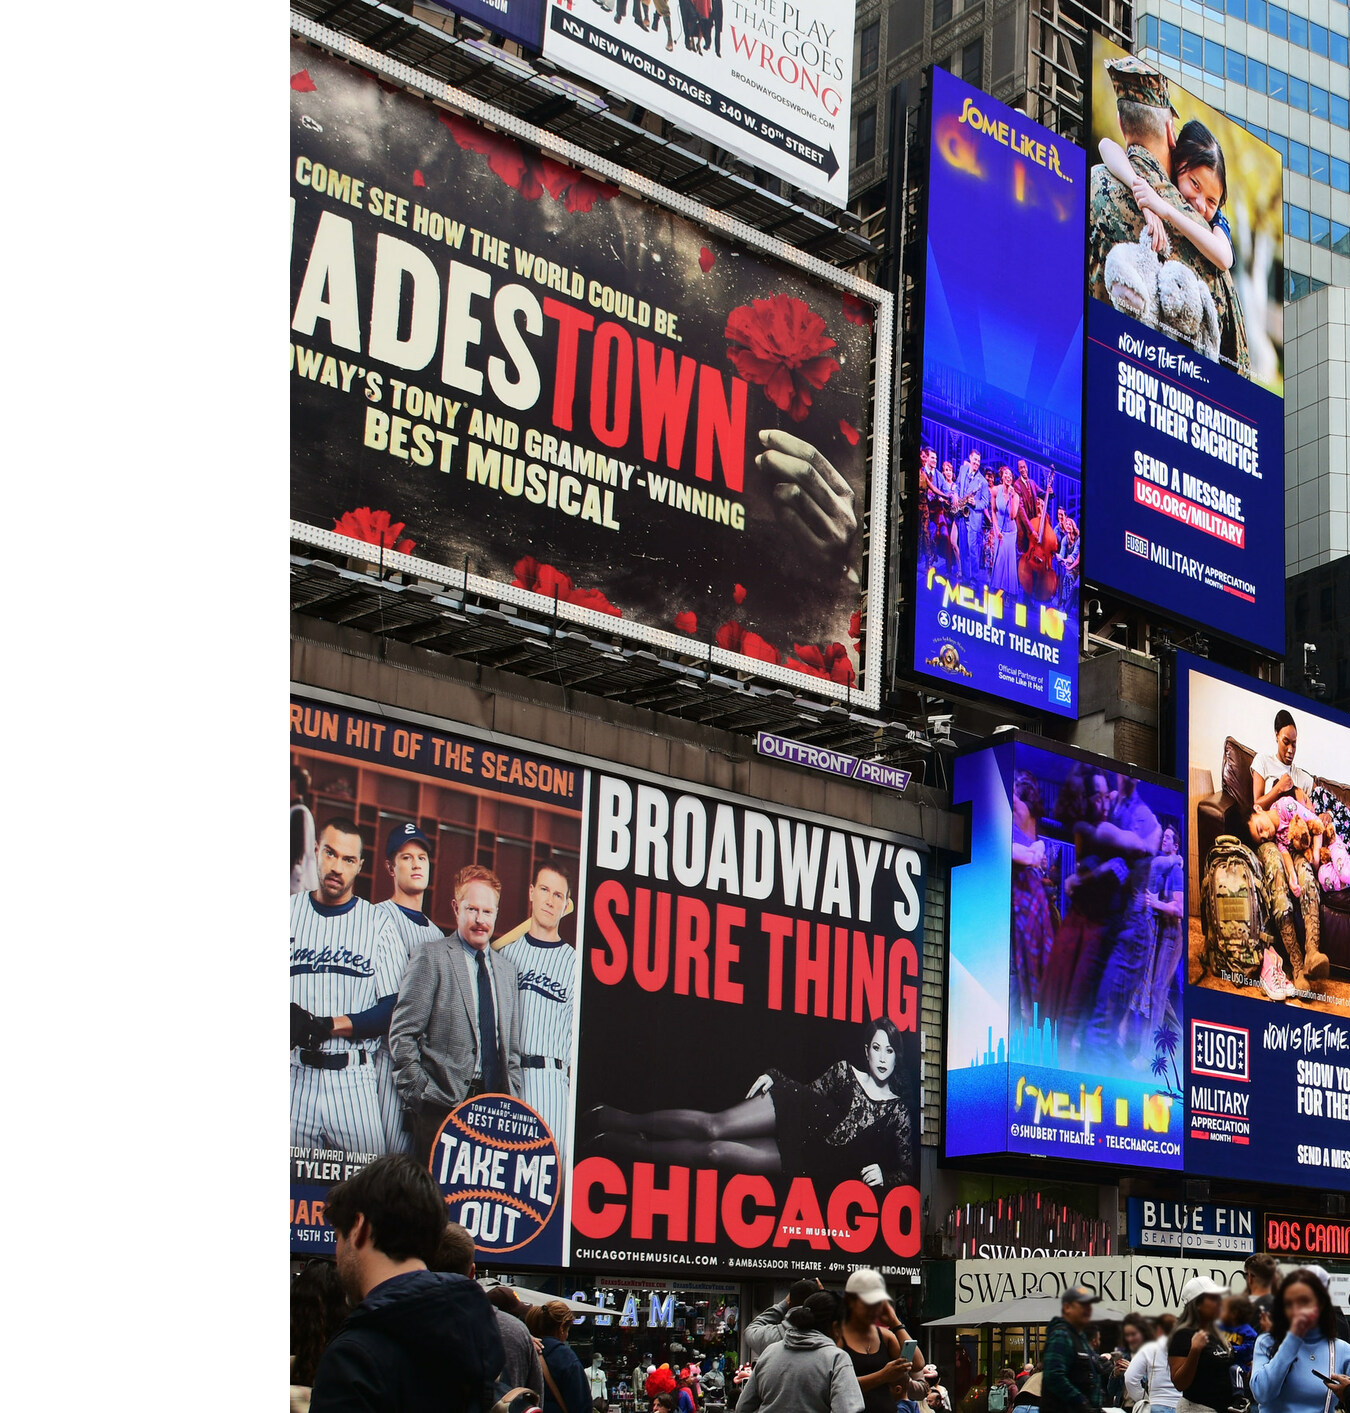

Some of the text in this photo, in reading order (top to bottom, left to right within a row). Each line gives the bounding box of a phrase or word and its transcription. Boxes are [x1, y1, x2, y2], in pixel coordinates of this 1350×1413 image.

[732, 0, 844, 81] THAT GOES
[783, 2, 836, 48] PLAY
[730, 24, 843, 117] WRONG
[588, 32, 824, 165] NEW WORLD STAGES 340 W. 50TH STREET
[731, 69, 836, 131] BROADWAYGOESWRONG.COM
[958, 98, 1009, 146] SOME
[295, 155, 683, 342] COME SEE HOW THE WORLD COULD BE.
[290, 197, 749, 493] ADESTOWN
[1145, 345, 1156, 361] IS
[1118, 361, 1258, 451] SHOW YOUR GRATITUDE
[467, 407, 520, 451] AND
[1117, 384, 1263, 480] FOR THEIR SACRIFICE.
[364, 407, 620, 530] BEST MUSICAL
[1134, 449, 1245, 523] SEND A MESSAGE.
[1136, 481, 1244, 545] USO.ORG/MILITARY
[1150, 541, 1256, 595] MILITARY APPRECIATION
[1204, 576, 1224, 591] MONTH
[951, 614, 1006, 647] SHUBERT
[1008, 633, 1060, 665] THEATRE
[290, 702, 575, 798] RUN HIT OF THE SEASON!
[762, 734, 906, 790] OUTFRONT PRIME
[596, 774, 922, 932] BROADWAY'S
[590, 879, 919, 1033] SURE THING
[1221, 969, 1231, 981] The
[1231, 972, 1244, 984] USO
[1204, 1031, 1237, 1070] USO
[1263, 1022, 1302, 1051] NOW IS
[1297, 1059, 1334, 1089] SHOW
[471, 1103, 487, 1113] TONY
[500, 1101, 511, 1110] THE
[1191, 1086, 1249, 1116] MILITARY
[1297, 1086, 1323, 1117] FOR
[467, 1111, 540, 1139] BEST REVIVAL
[1019, 1124, 1181, 1156] SHUBERT THEATRE TELECHARGE.COM
[1191, 1116, 1250, 1135] APPRECIATION
[1210, 1132, 1232, 1143] MONTH
[296, 1160, 341, 1181] TYLER
[313, 1148, 344, 1162] AWARD
[439, 1131, 556, 1206] TAKE ME
[1297, 1144, 1322, 1166] SEND
[1323, 1147, 1329, 1166] A
[459, 1200, 521, 1244] OUT
[571, 1156, 921, 1258] CHICAGO
[1143, 1201, 1252, 1235] BLUE FIN
[297, 1229, 337, 1243] 45TH ST.
[782, 1226, 850, 1238] THE MUSICAL
[1144, 1232, 1252, 1250] SEAFOOD SUSHI
[1268, 1220, 1300, 1251] DOS
[576, 1248, 718, 1266] CHICAGOTHEMUSICAL.COM
[735, 1257, 789, 1270] AMBASSADOR
[791, 1260, 822, 1271] THEATRE
[828, 1262, 844, 1272] 49TH
[882, 1265, 921, 1276] BROADWAY
[958, 1271, 1127, 1304] SWAROVSKI
